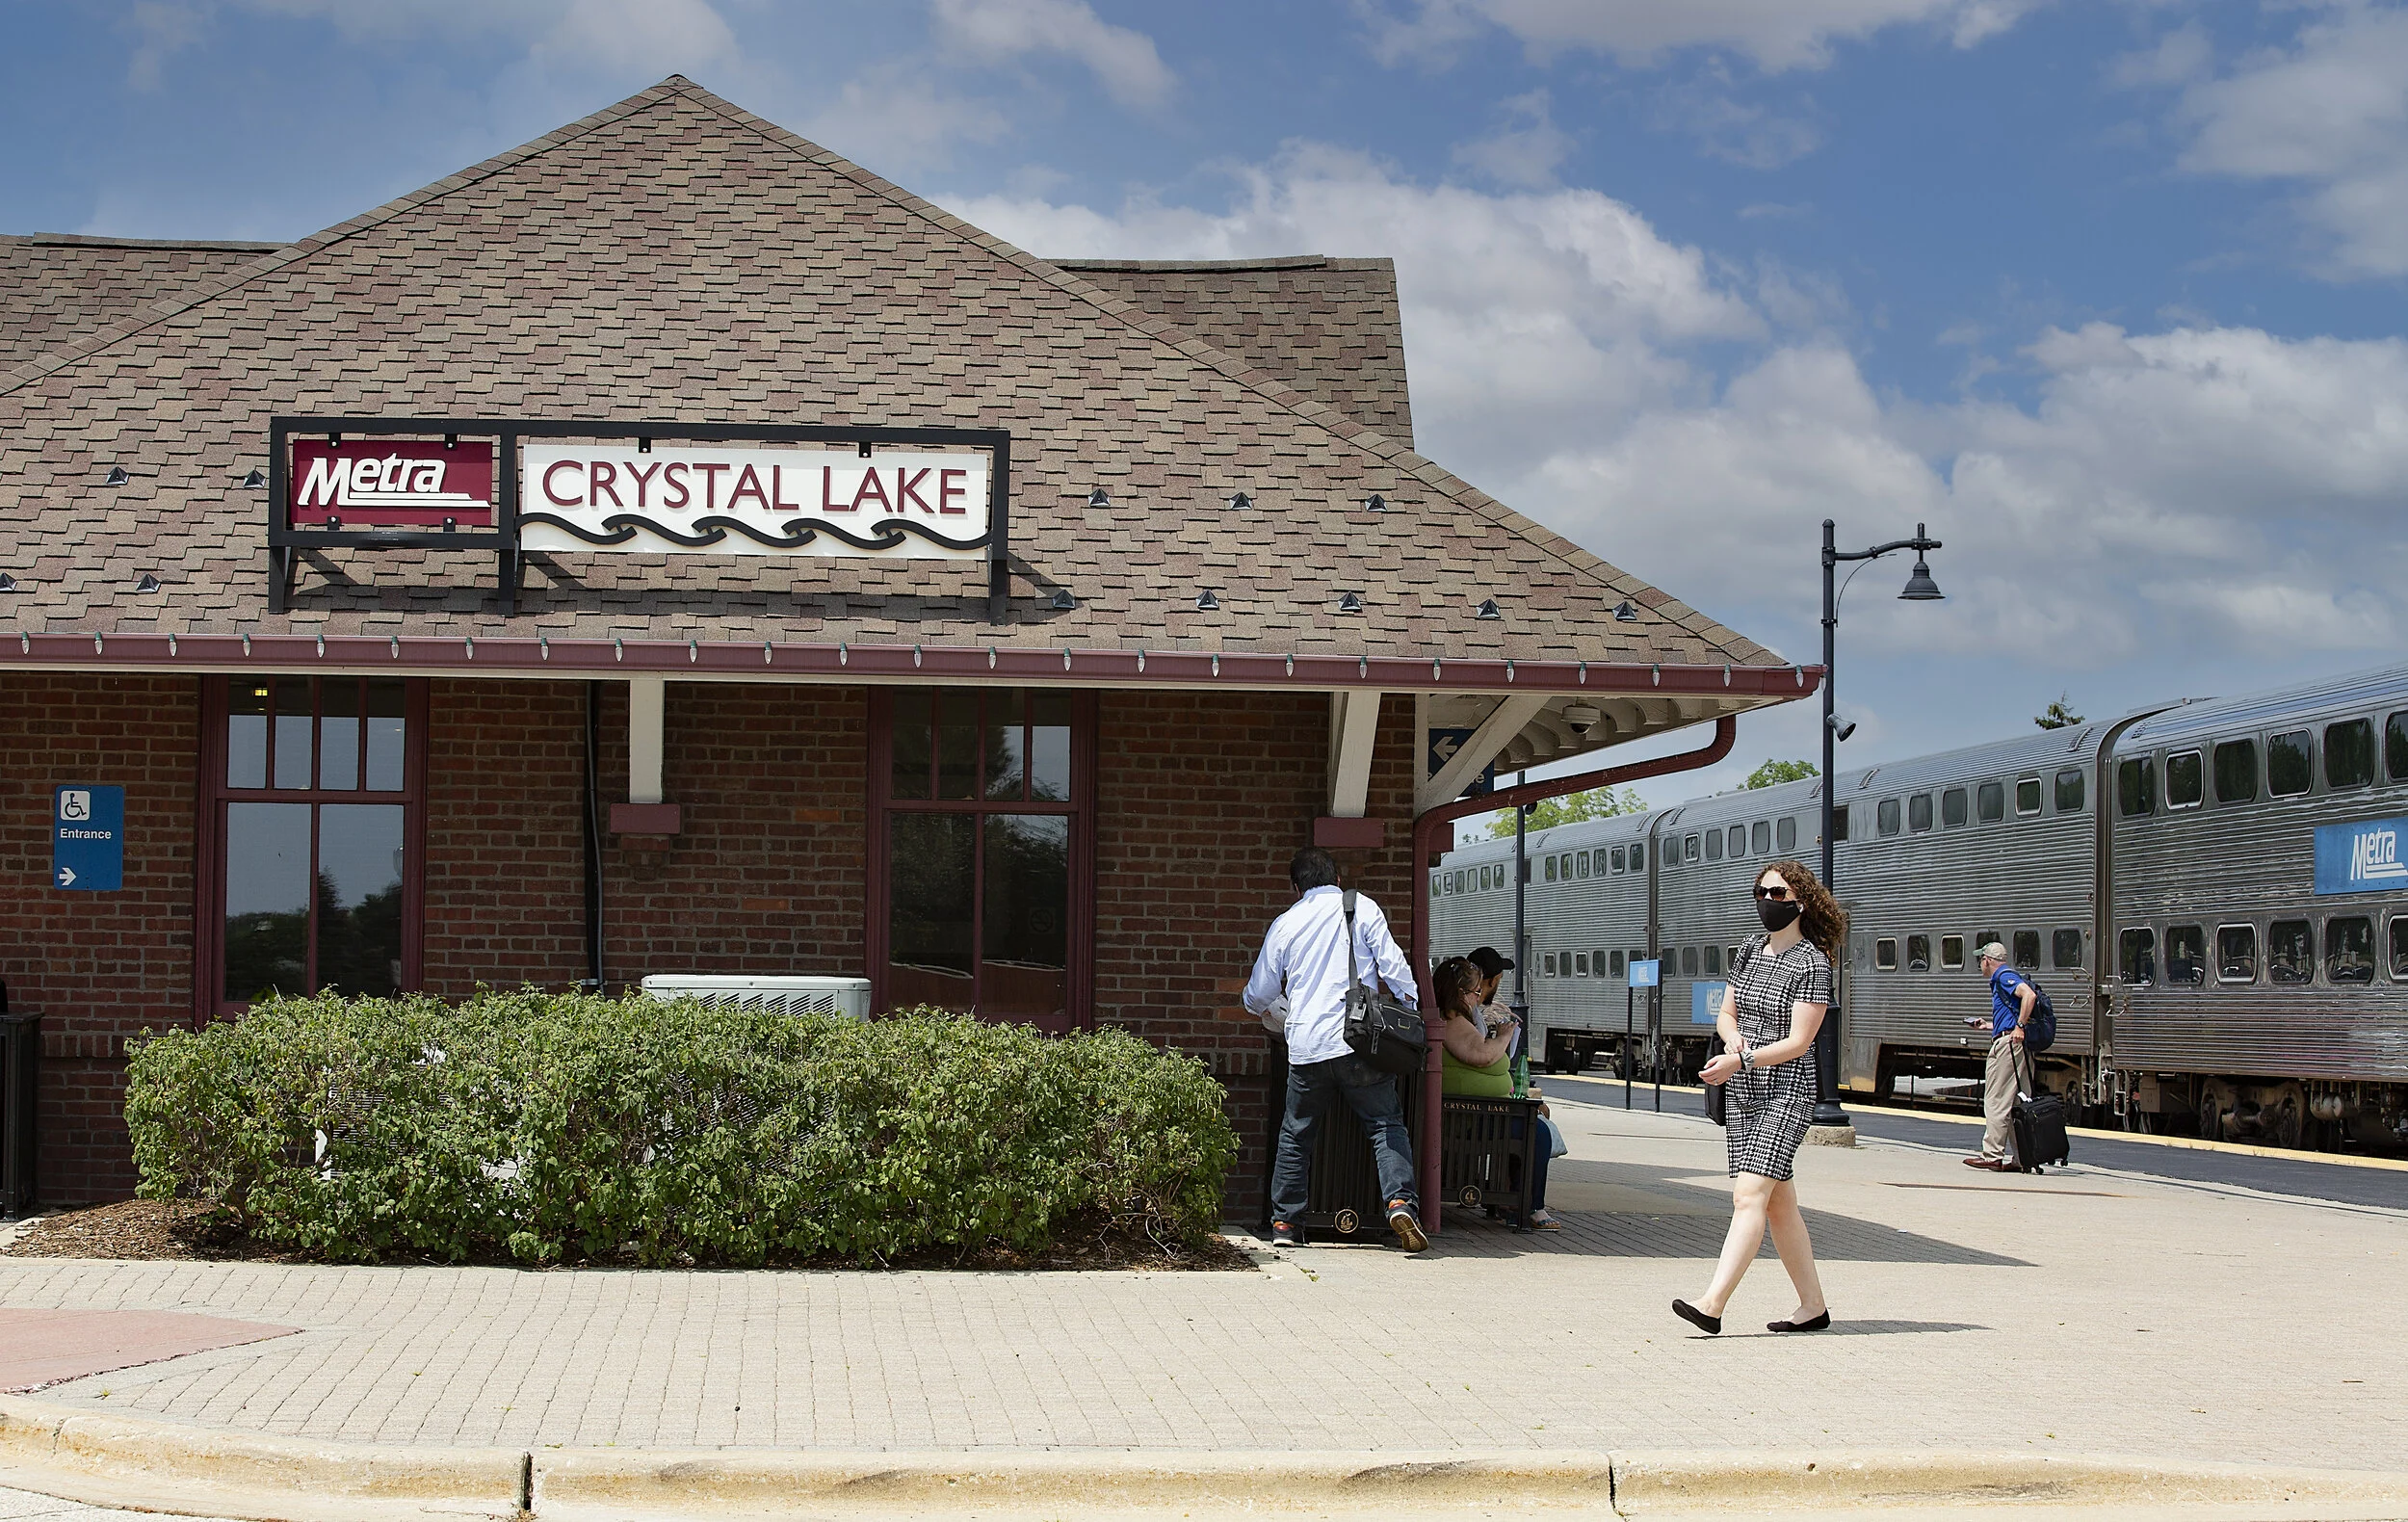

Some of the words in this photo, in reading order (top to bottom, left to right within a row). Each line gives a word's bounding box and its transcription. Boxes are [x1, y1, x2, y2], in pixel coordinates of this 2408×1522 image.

[298, 453, 448, 507] Metra
[542, 459, 799, 511] CRYSTAL
[822, 465, 967, 514] LAKE
[60, 827, 112, 839] Entrance
[2350, 827, 2396, 880] Metra
[1444, 1102, 1481, 1111] CRYSTAL
